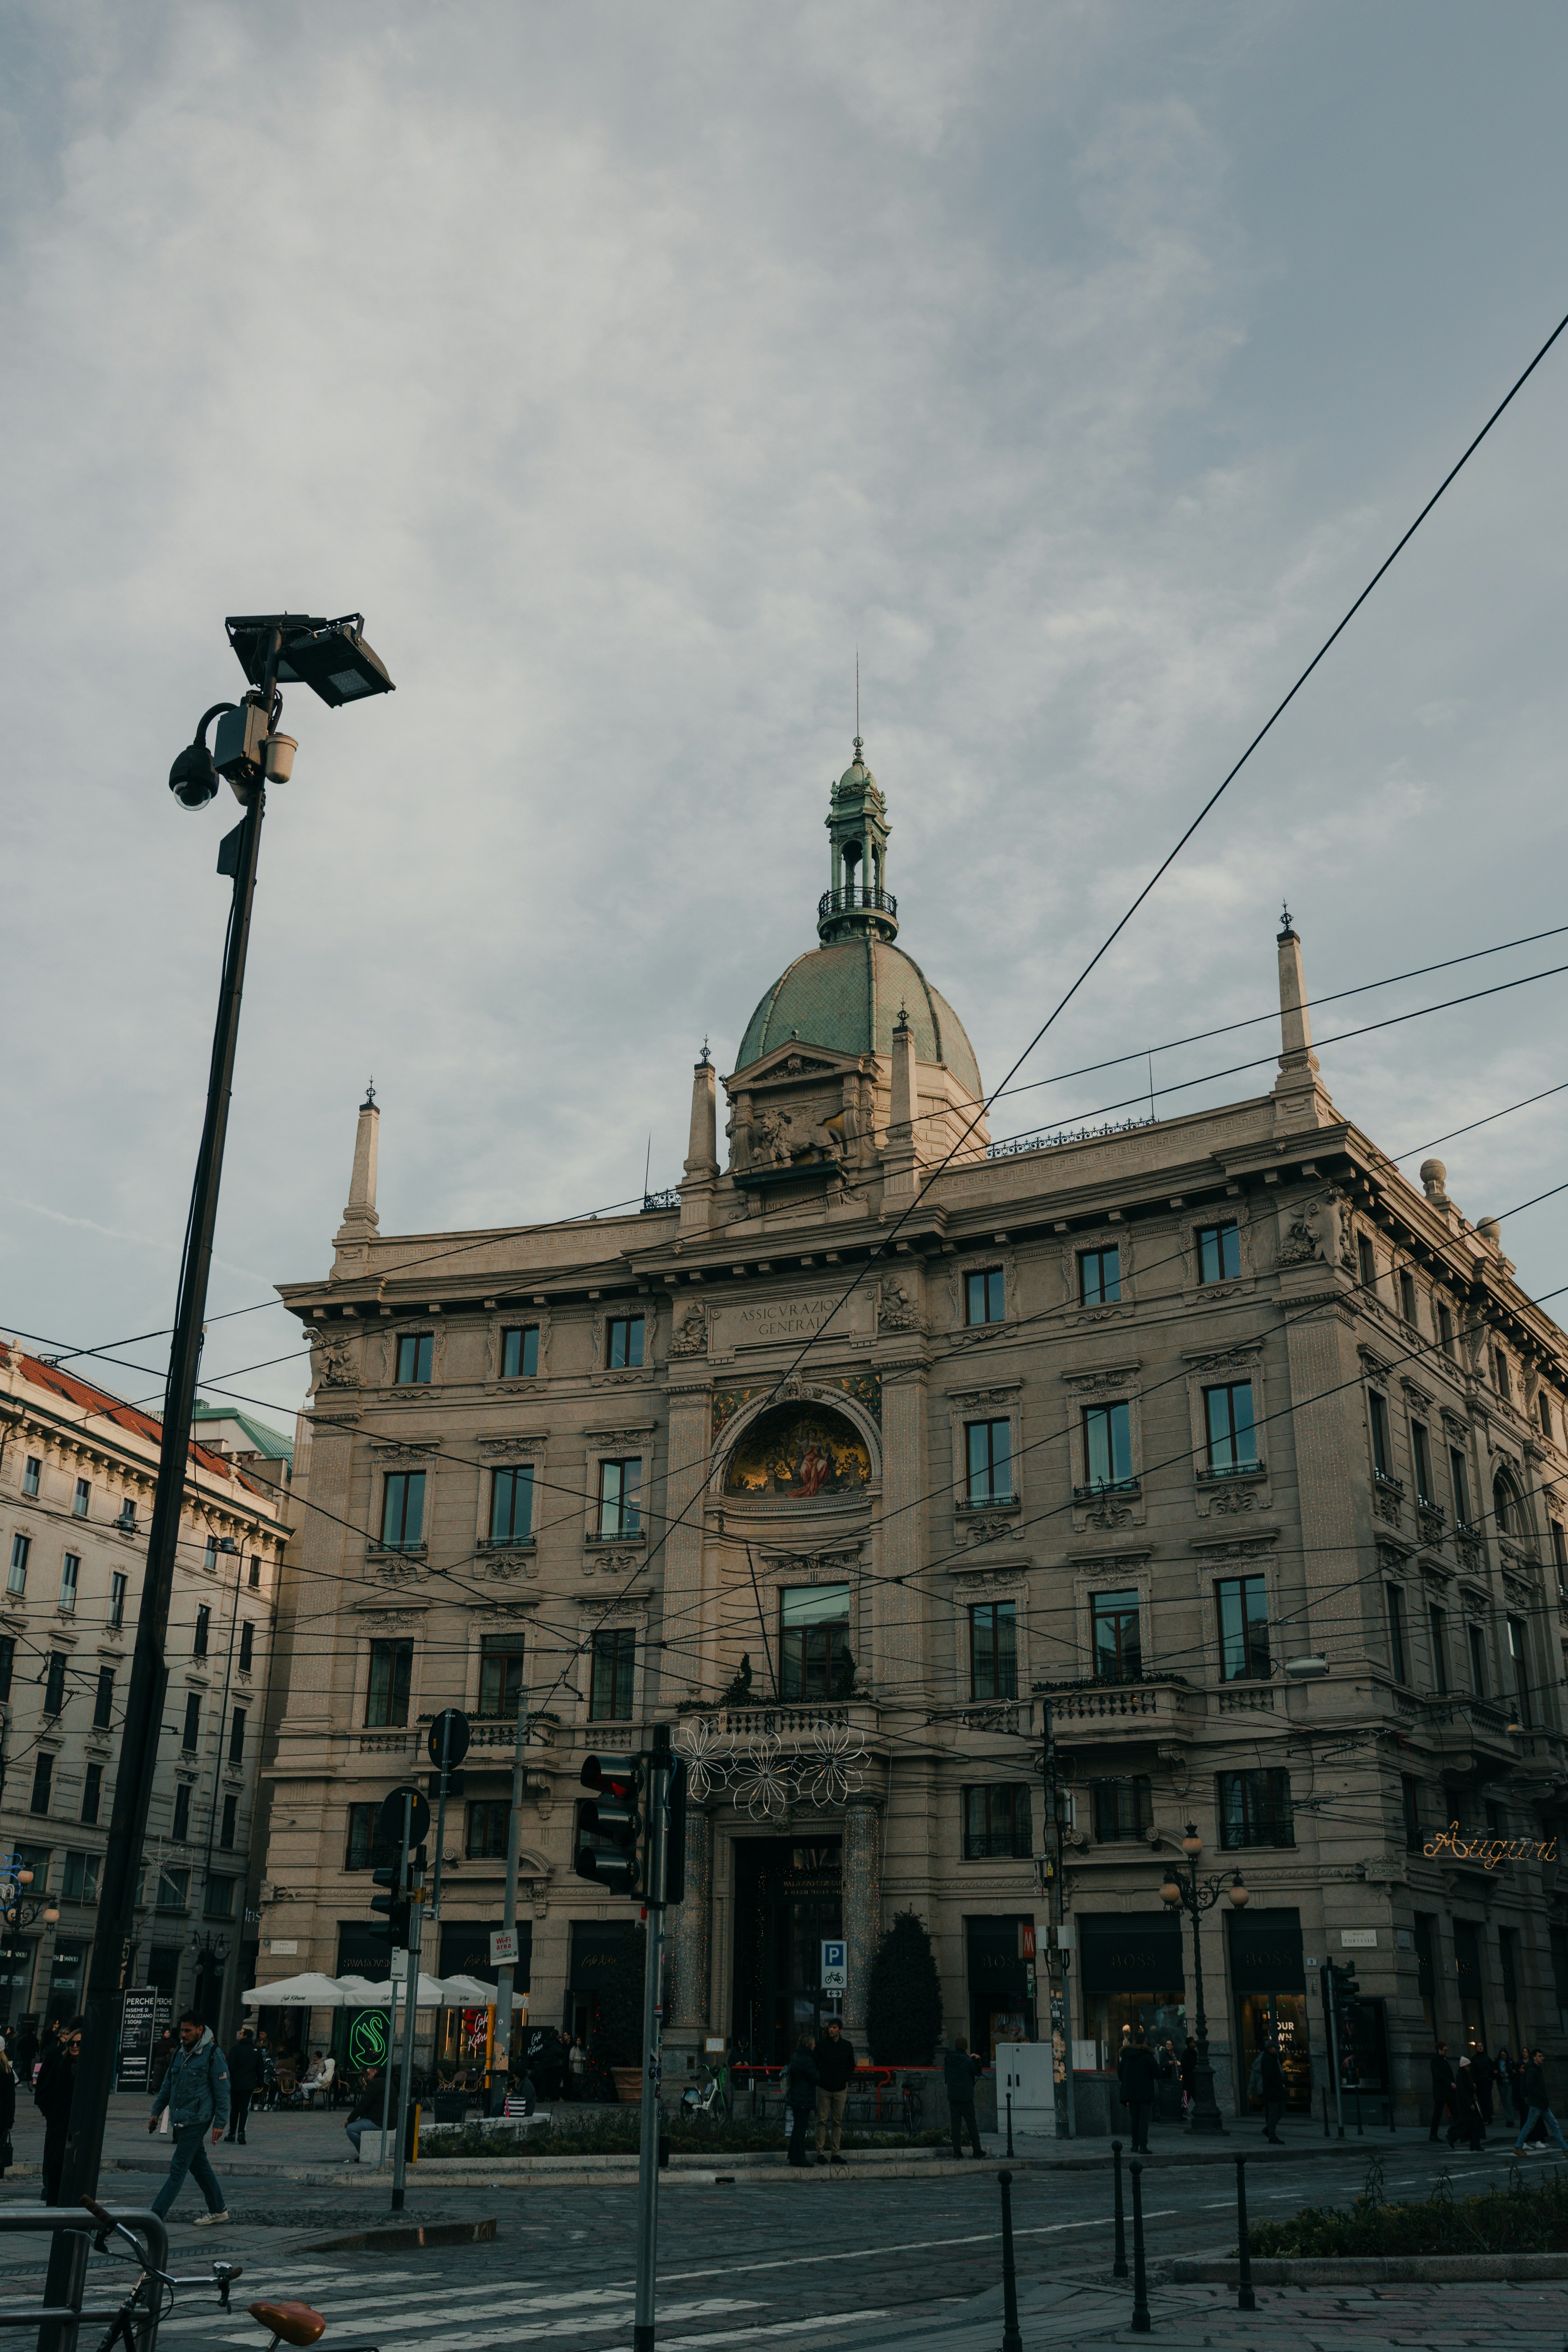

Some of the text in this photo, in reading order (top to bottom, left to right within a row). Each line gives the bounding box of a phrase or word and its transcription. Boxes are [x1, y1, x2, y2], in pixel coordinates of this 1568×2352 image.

[740, 1298, 848, 1322] ASSICVRAZIONI
[759, 1316, 827, 1335] GENERALI
[720, 1715, 725, 1723] 89
[1423, 1820, 1558, 1869] Auguri
[496, 1936, 511, 1944] Wi-Fi
[1024, 1931, 1034, 1952] M
[829, 1947, 840, 1963] P
[982, 1954, 1025, 1970] BOSS
[1111, 1953, 1156, 1969] BOSS
[1244, 1951, 1292, 1967] BOSS
[1027, 1967, 1034, 1975] WC
